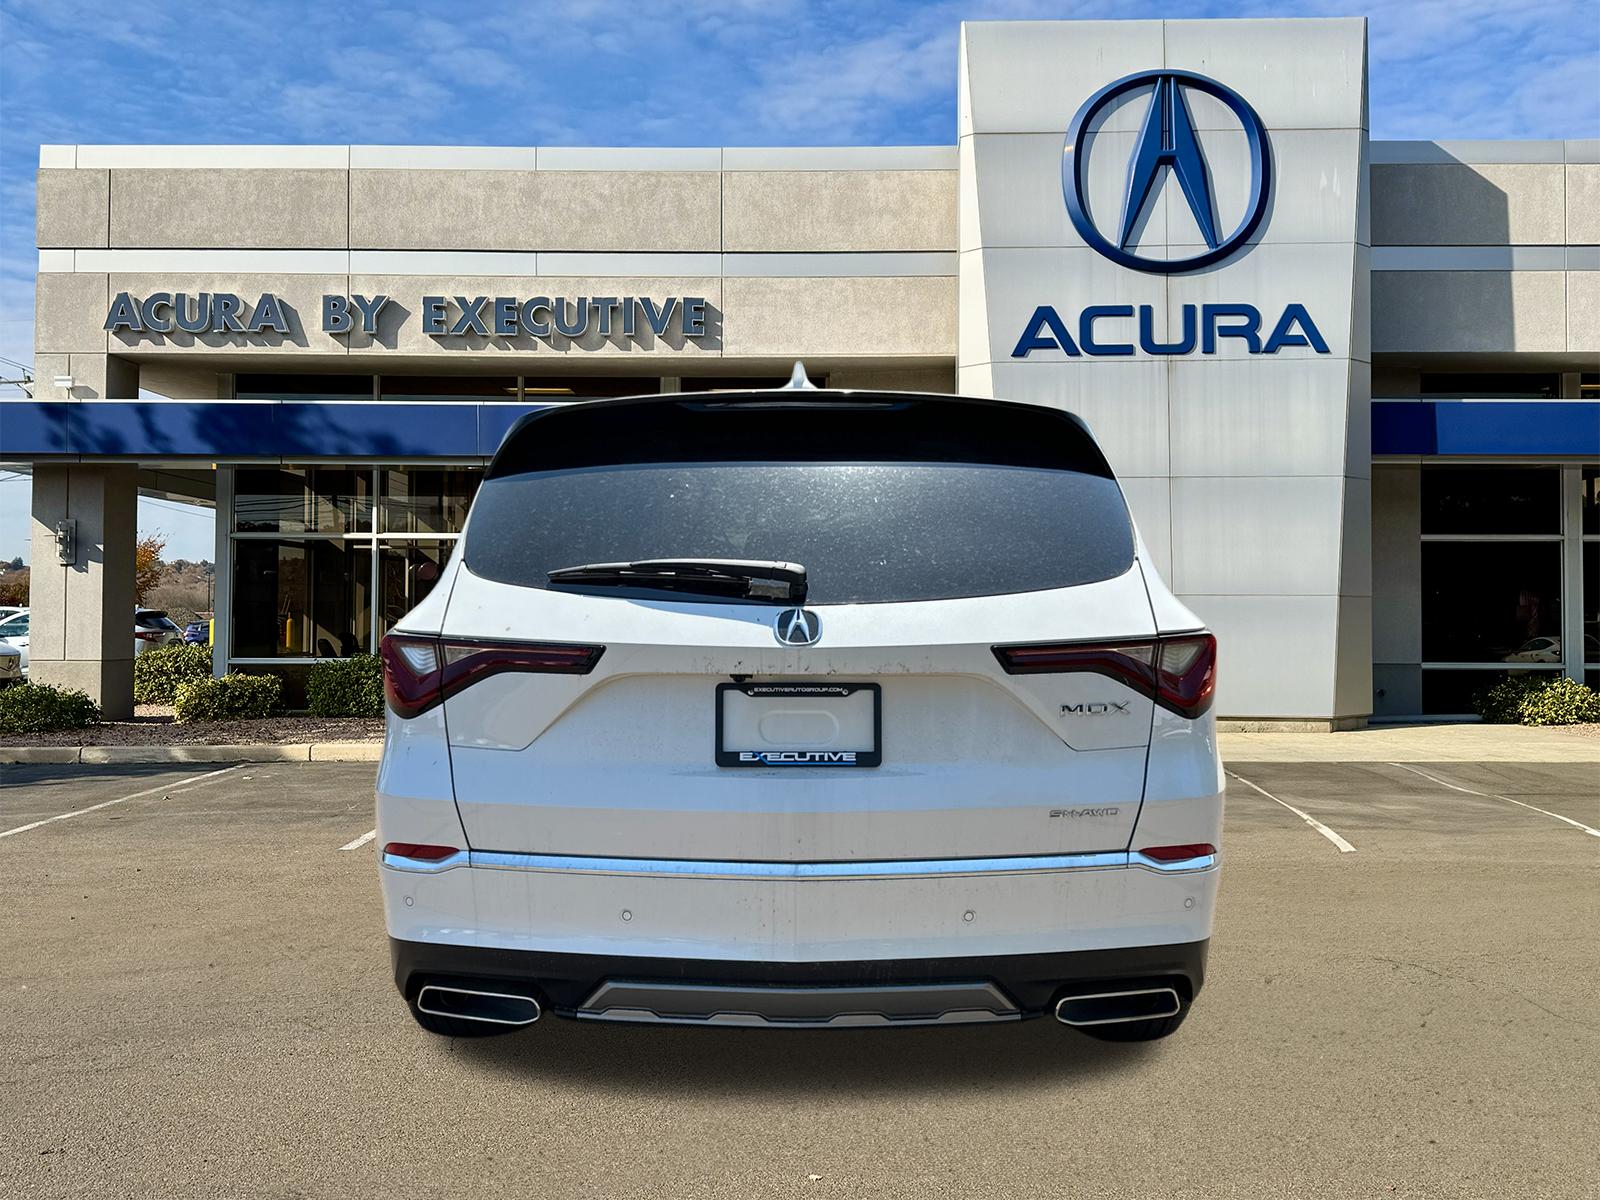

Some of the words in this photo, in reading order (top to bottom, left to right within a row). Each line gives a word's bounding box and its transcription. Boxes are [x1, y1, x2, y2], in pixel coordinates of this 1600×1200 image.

[105, 291, 290, 334] ACURA
[322, 295, 392, 336] BY
[422, 296, 708, 338] EXECUTIVE
[1011, 303, 1331, 358] ACURA
[1060, 701, 1131, 717] MDX
[739, 752, 857, 763] EXECUTIVE
